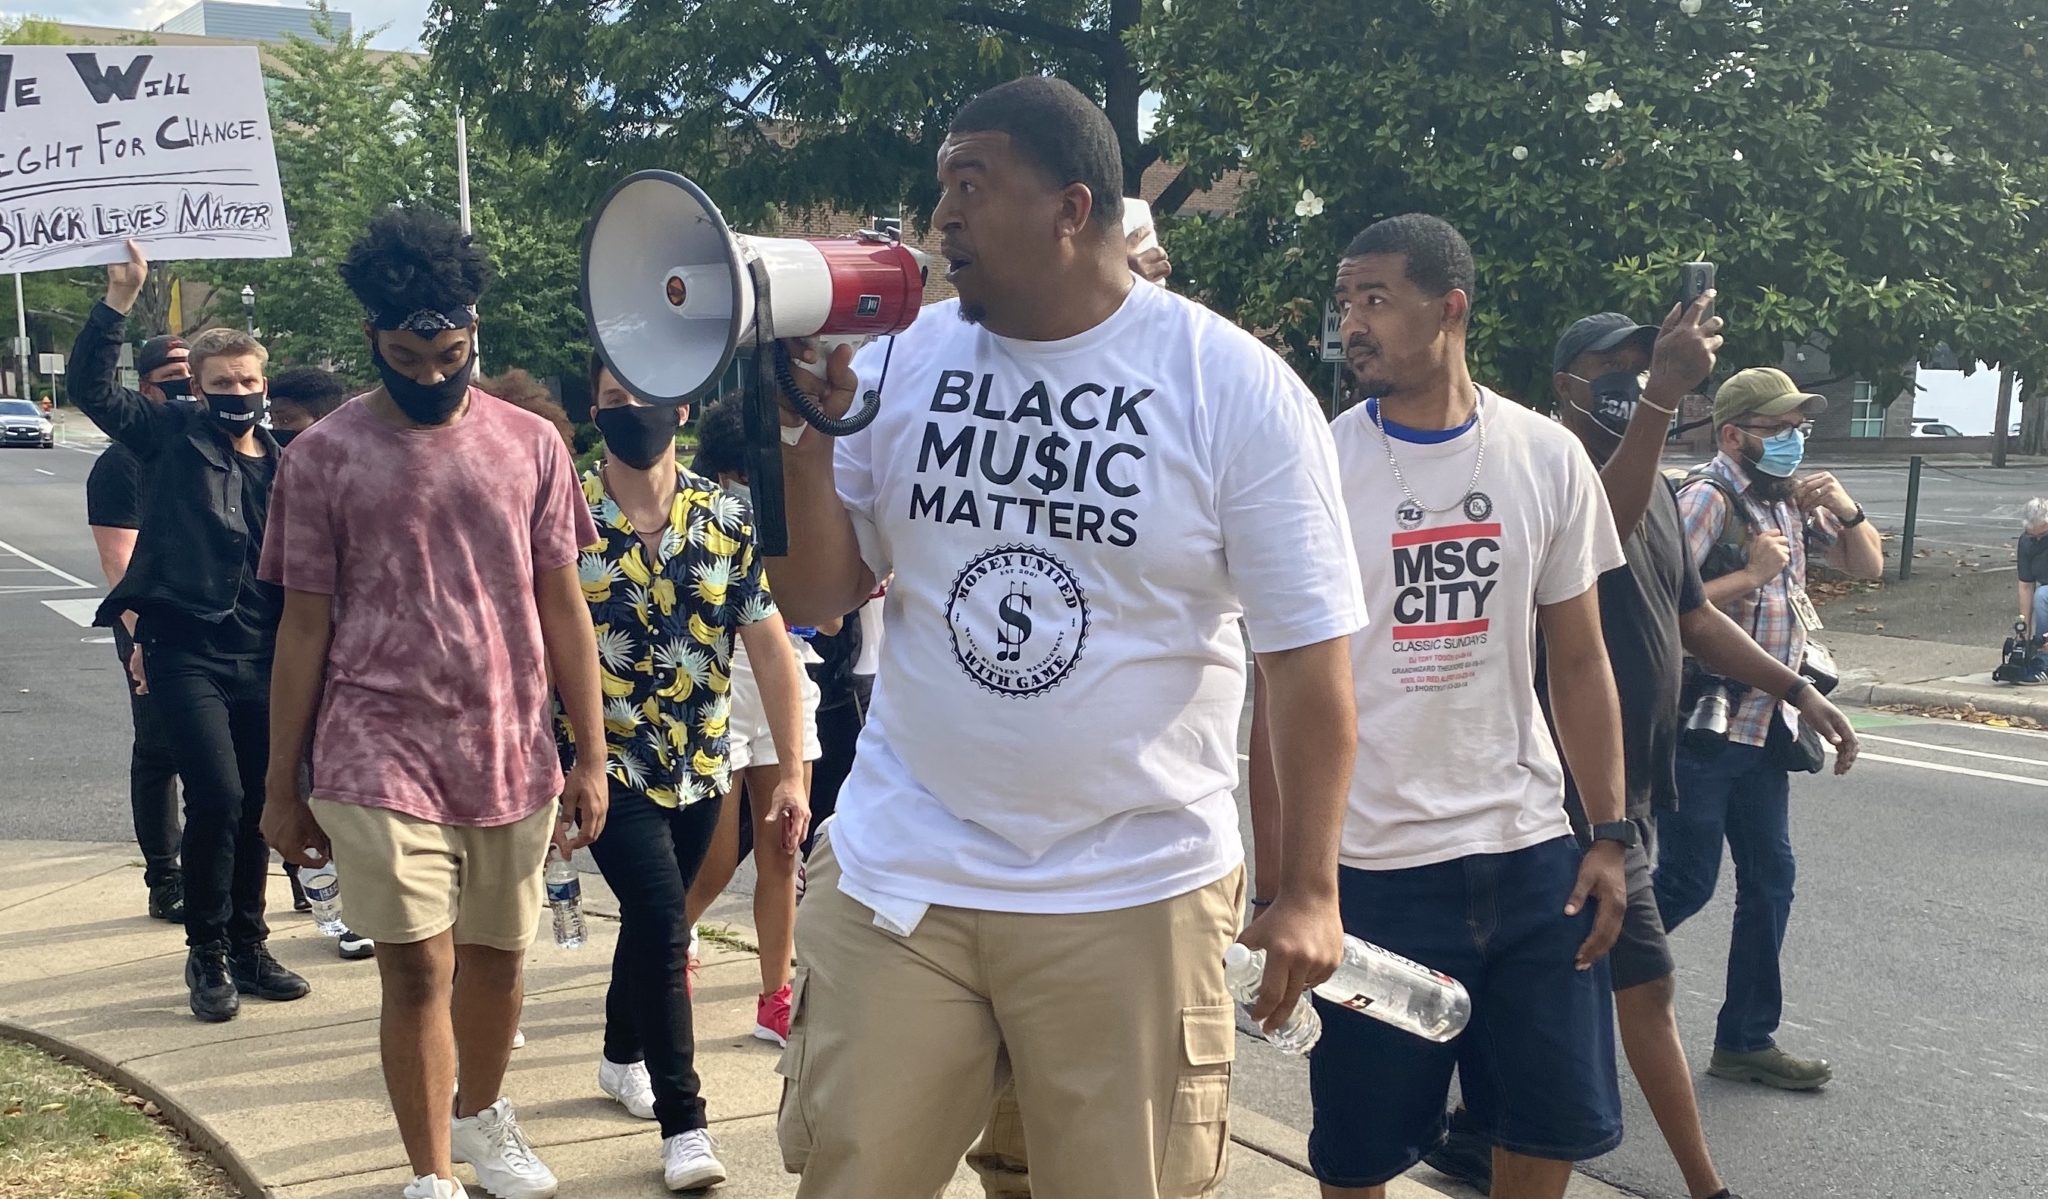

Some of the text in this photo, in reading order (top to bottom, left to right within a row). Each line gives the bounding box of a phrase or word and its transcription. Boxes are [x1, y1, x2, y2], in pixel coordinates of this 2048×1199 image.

[0, 53, 190, 112] E WILL
[97, 121, 145, 164] FOR
[155, 116, 261, 149] CHANGE.
[96, 204, 166, 235] LIVES
[178, 192, 269, 233] MATTER
[1327, 316, 1341, 332] WA
[930, 370, 1155, 435] BLACK
[917, 422, 1146, 497] MU$IC
[909, 484, 1138, 547] MATTERS
[958, 554, 1077, 609] MONEY UNITED
[1393, 538, 1500, 587] MSC
[1393, 580, 1498, 624] CITY
[1392, 633, 1488, 653] CLASSIC SUNDAYS
[964, 650, 1067, 689] WITH GAME
